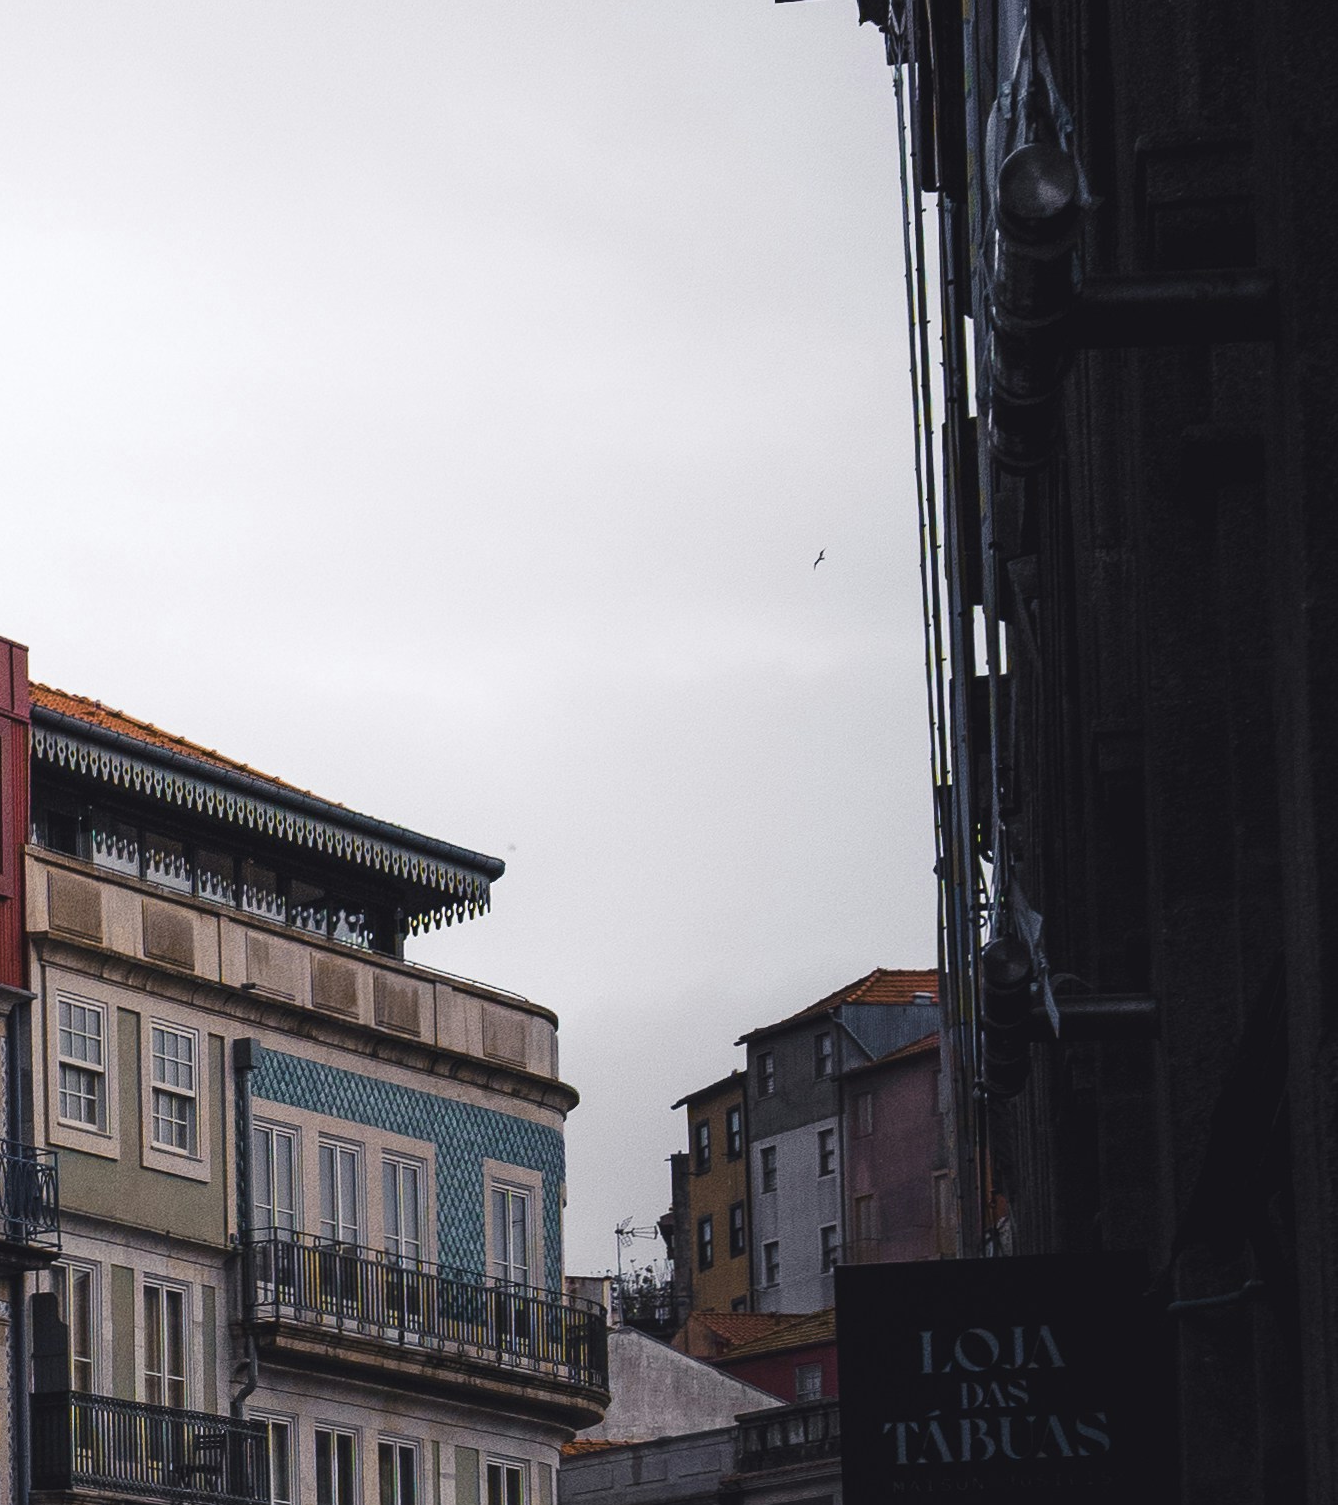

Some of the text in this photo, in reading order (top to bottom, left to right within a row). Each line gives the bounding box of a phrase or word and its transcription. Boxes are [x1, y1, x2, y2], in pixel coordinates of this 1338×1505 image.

[918, 1324, 1066, 1374] LOJA
[959, 1378, 1030, 1409] DAS
[882, 1409, 1112, 1465] TÁBUAS
